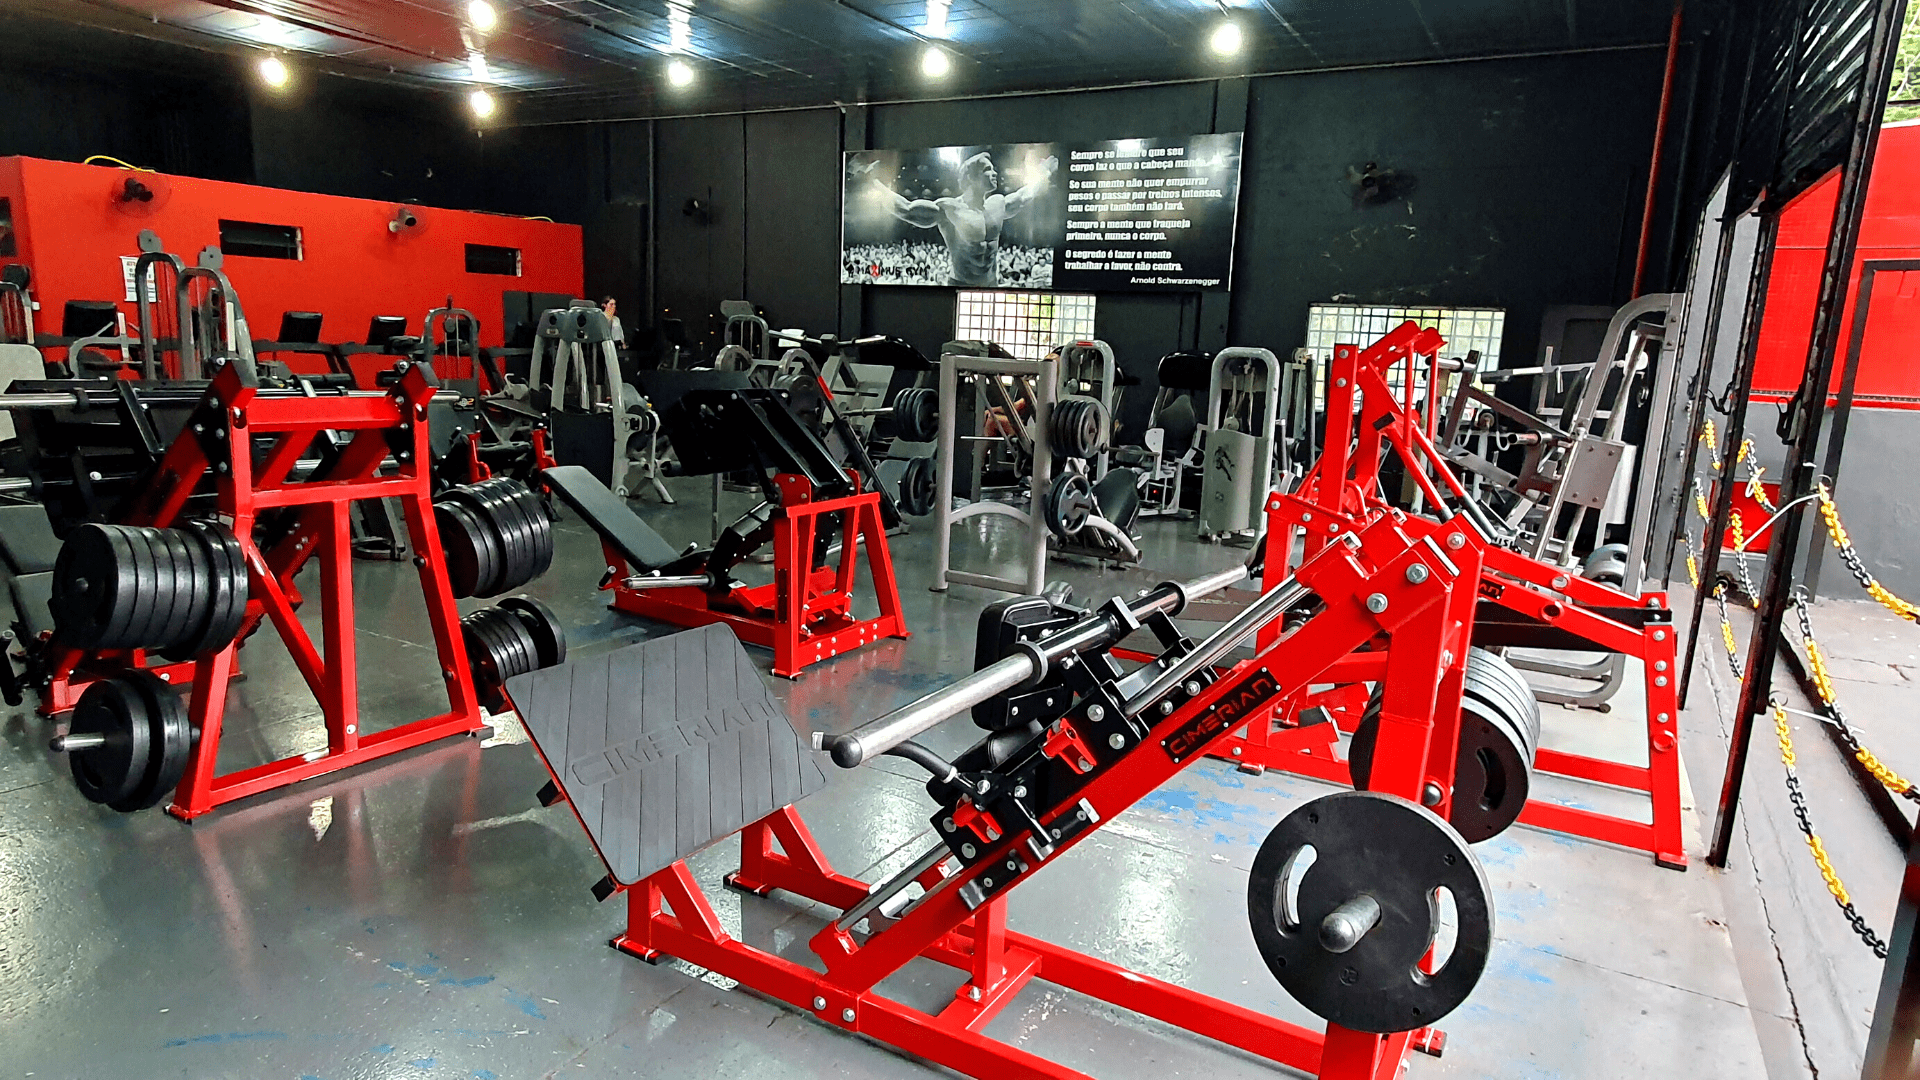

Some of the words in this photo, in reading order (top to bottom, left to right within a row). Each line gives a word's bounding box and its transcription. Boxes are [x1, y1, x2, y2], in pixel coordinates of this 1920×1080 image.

[1070, 150, 1104, 160] Sempre
[1104, 151, 1114, 159] se
[1148, 148, 1166, 158] que
[1167, 148, 1184, 156] seu
[1070, 163, 1094, 172] corpo
[1096, 162, 1108, 170] faz
[1109, 162, 1114, 170] o
[1116, 162, 1132, 172] que
[1134, 162, 1140, 170] a
[1141, 160, 1174, 170] cabeça
[1069, 180, 1080, 189] Se
[1081, 180, 1097, 188] sua
[1098, 180, 1125, 188] mente
[1126, 178, 1142, 188] não
[1144, 179, 1164, 188] quer
[1166, 178, 1209, 187] empurrar
[1069, 192, 1094, 201] pesos
[1095, 192, 1100, 200] e
[1102, 192, 1131, 200] passar
[1132, 191, 1147, 200] por
[1148, 190, 1180, 199] treinos
[1068, 204, 1083, 212] seu
[1084, 204, 1109, 213] corpo
[1110, 202, 1145, 211] também
[1146, 202, 1163, 211] não
[1067, 220, 1099, 230] Sempre
[1107, 220, 1134, 229] mente
[1135, 220, 1152, 230] que
[1152, 219, 1190, 229] fraqueja
[1139, 232, 1167, 241] corpo.
[1065, 250, 1071, 258] O
[1072, 250, 1106, 260] segredo
[1108, 249, 1114, 258] é
[1115, 250, 1136, 258] fazer
[1137, 251, 1142, 259] a
[1143, 250, 1172, 259] mente
[1065, 261, 1103, 270] trabalhar
[1104, 262, 1110, 270] a
[1134, 262, 1151, 271] não
[1152, 263, 1183, 271] contra.
[1130, 276, 1155, 284] Arnold
[1157, 277, 1220, 286] Schwarzenegger
[1169, 678, 1272, 754] CIMERIAN
